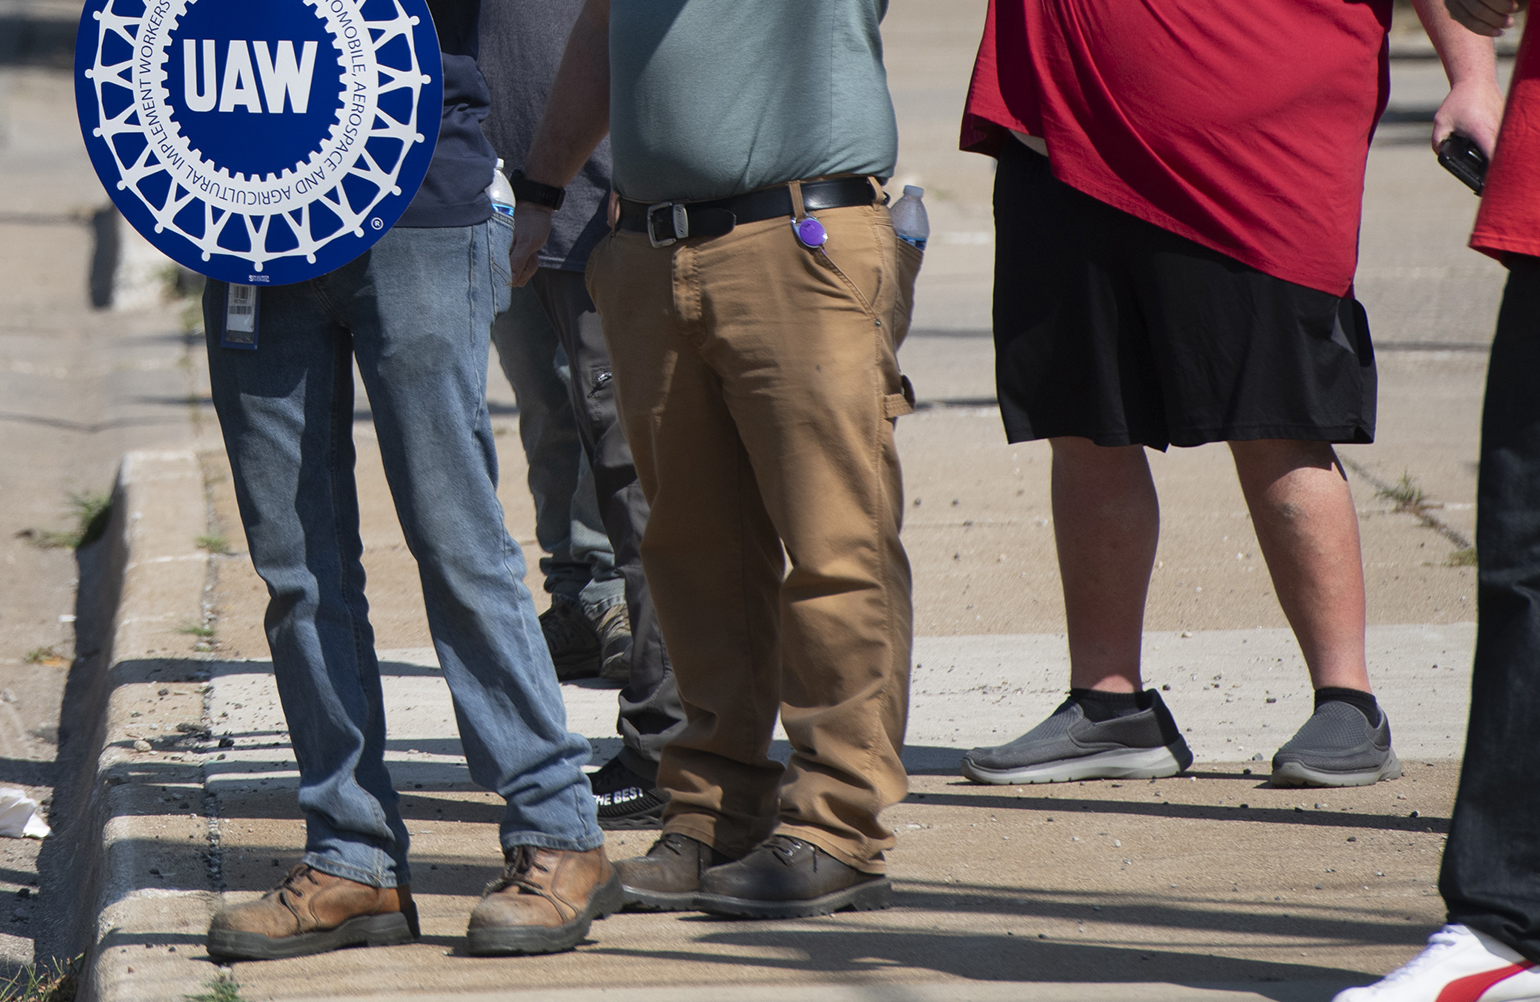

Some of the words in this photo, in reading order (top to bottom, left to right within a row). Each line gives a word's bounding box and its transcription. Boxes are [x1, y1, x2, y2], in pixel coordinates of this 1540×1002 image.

[183, 38, 318, 114] UAW
[139, 78, 186, 170] IMPLEMENT
[323, 81, 367, 172] AEROSPACE
[185, 164, 291, 205] AGRICULTURAL
[295, 166, 326, 195] AND
[613, 786, 644, 804] BEST
